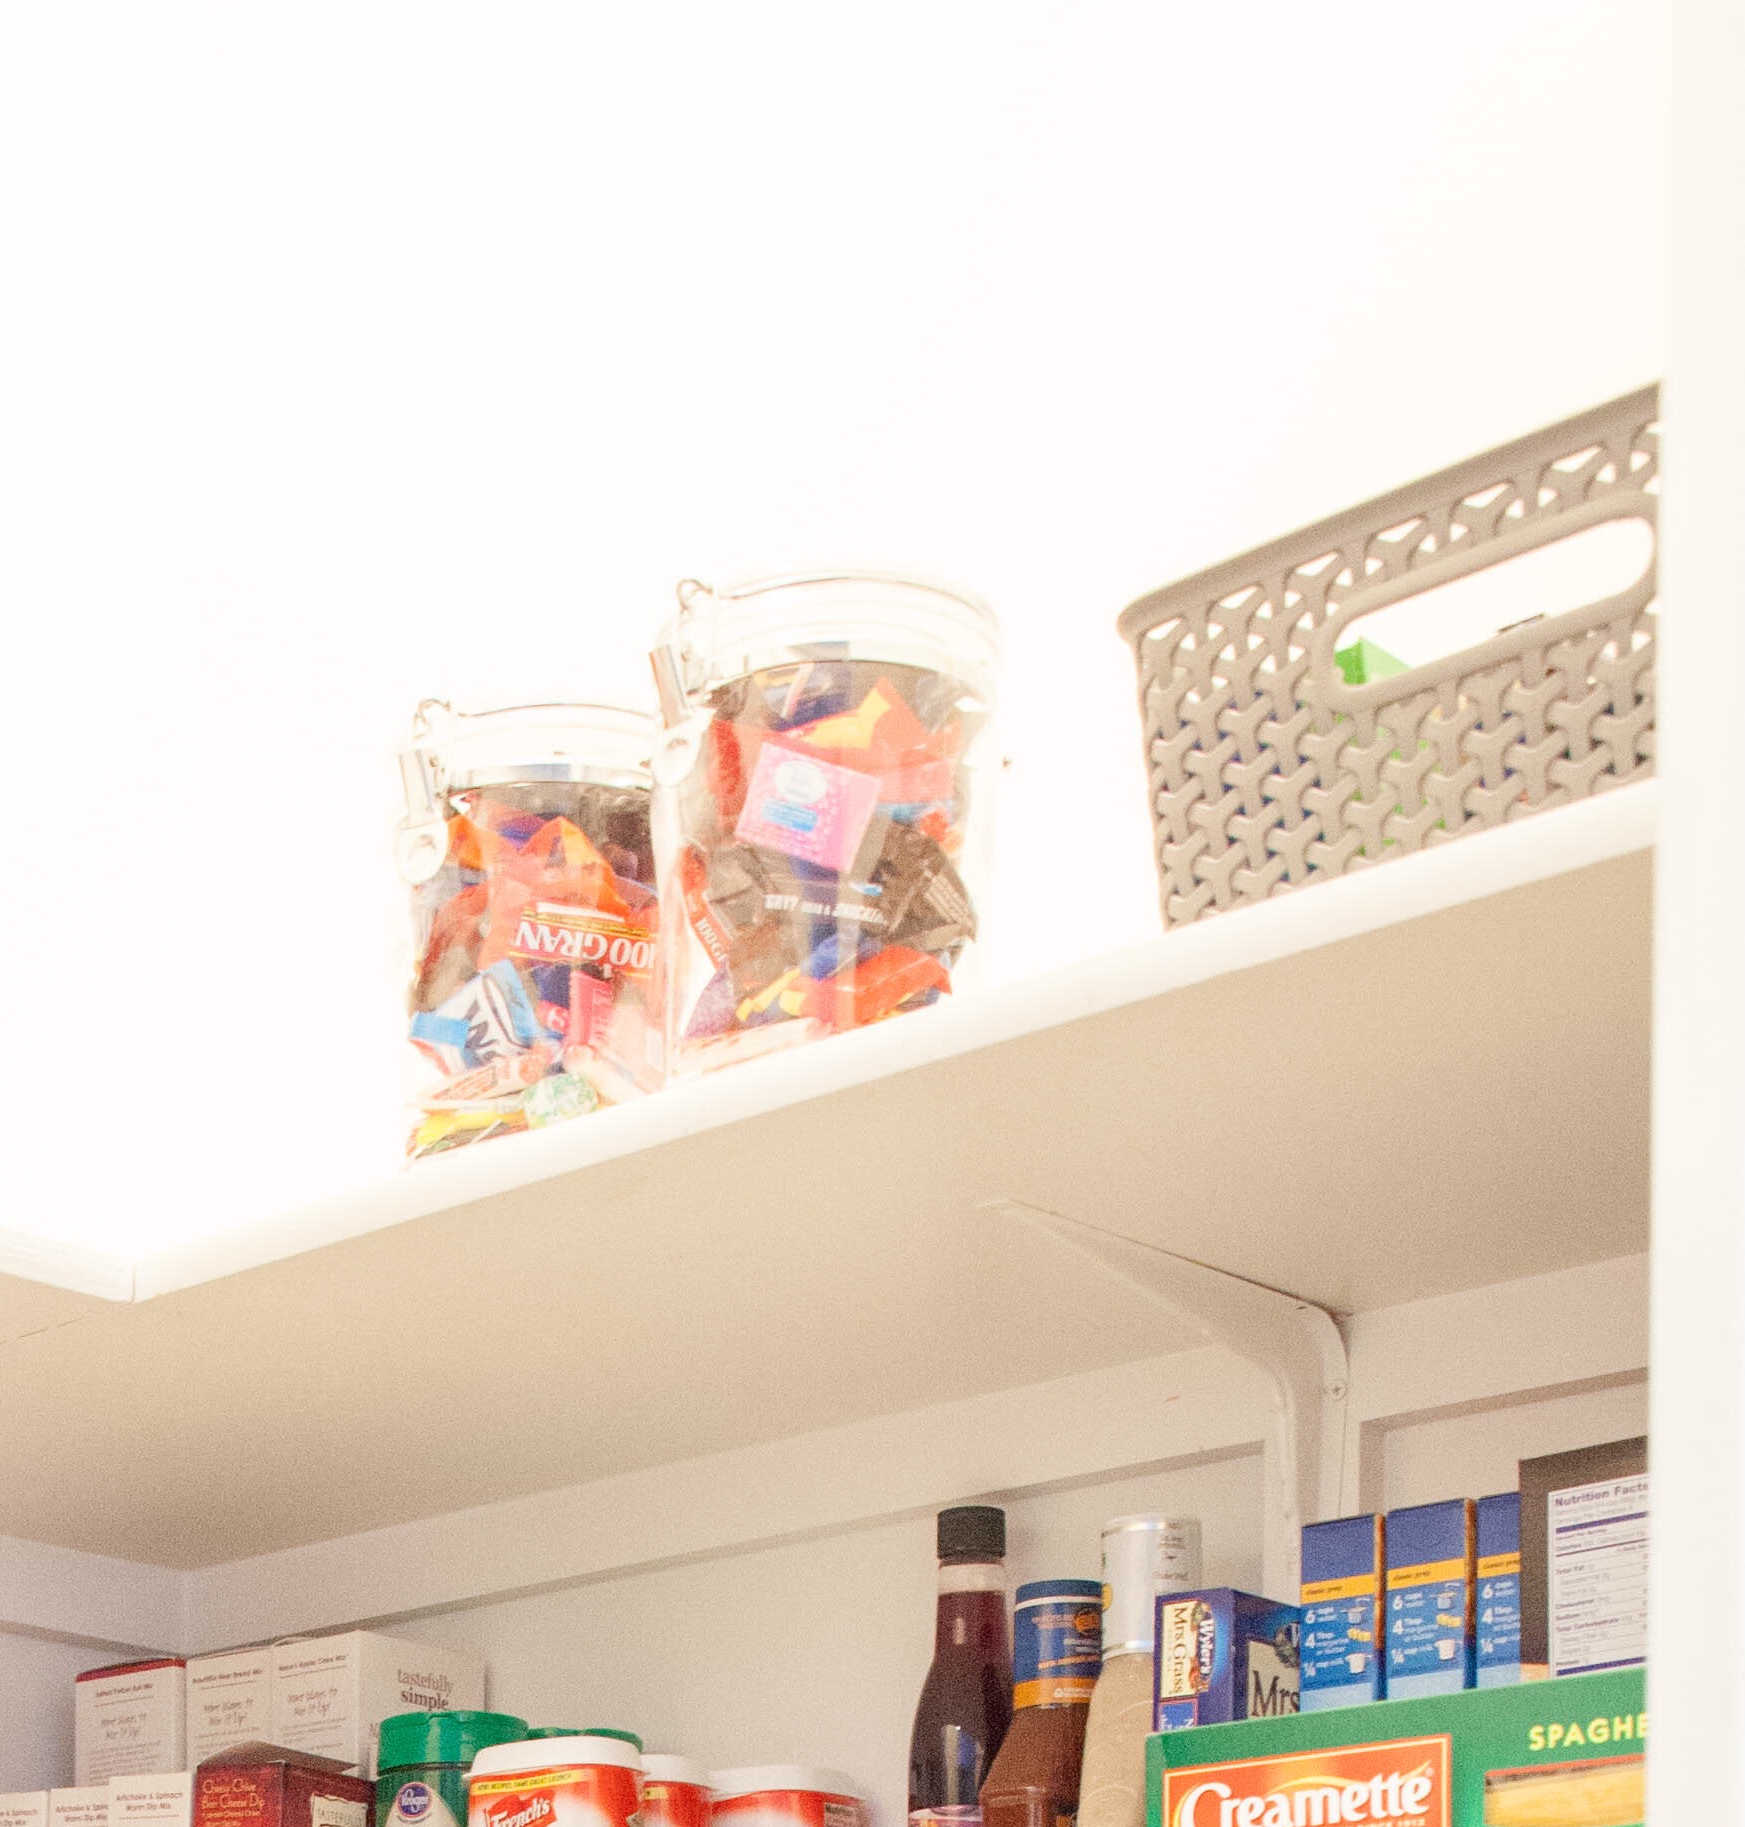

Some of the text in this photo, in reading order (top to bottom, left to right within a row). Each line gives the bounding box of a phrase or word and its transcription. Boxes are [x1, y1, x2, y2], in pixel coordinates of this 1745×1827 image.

[513, 920, 607, 961] GRAN
[1555, 1482, 1648, 1507] Nutrition Facts
[1483, 1584, 1492, 1599] 6
[398, 1668, 453, 1694] tastefully
[1252, 1670, 1301, 1718] Mrs
[400, 1688, 449, 1711] simple
[1528, 1714, 1646, 1751] SPAGHE
